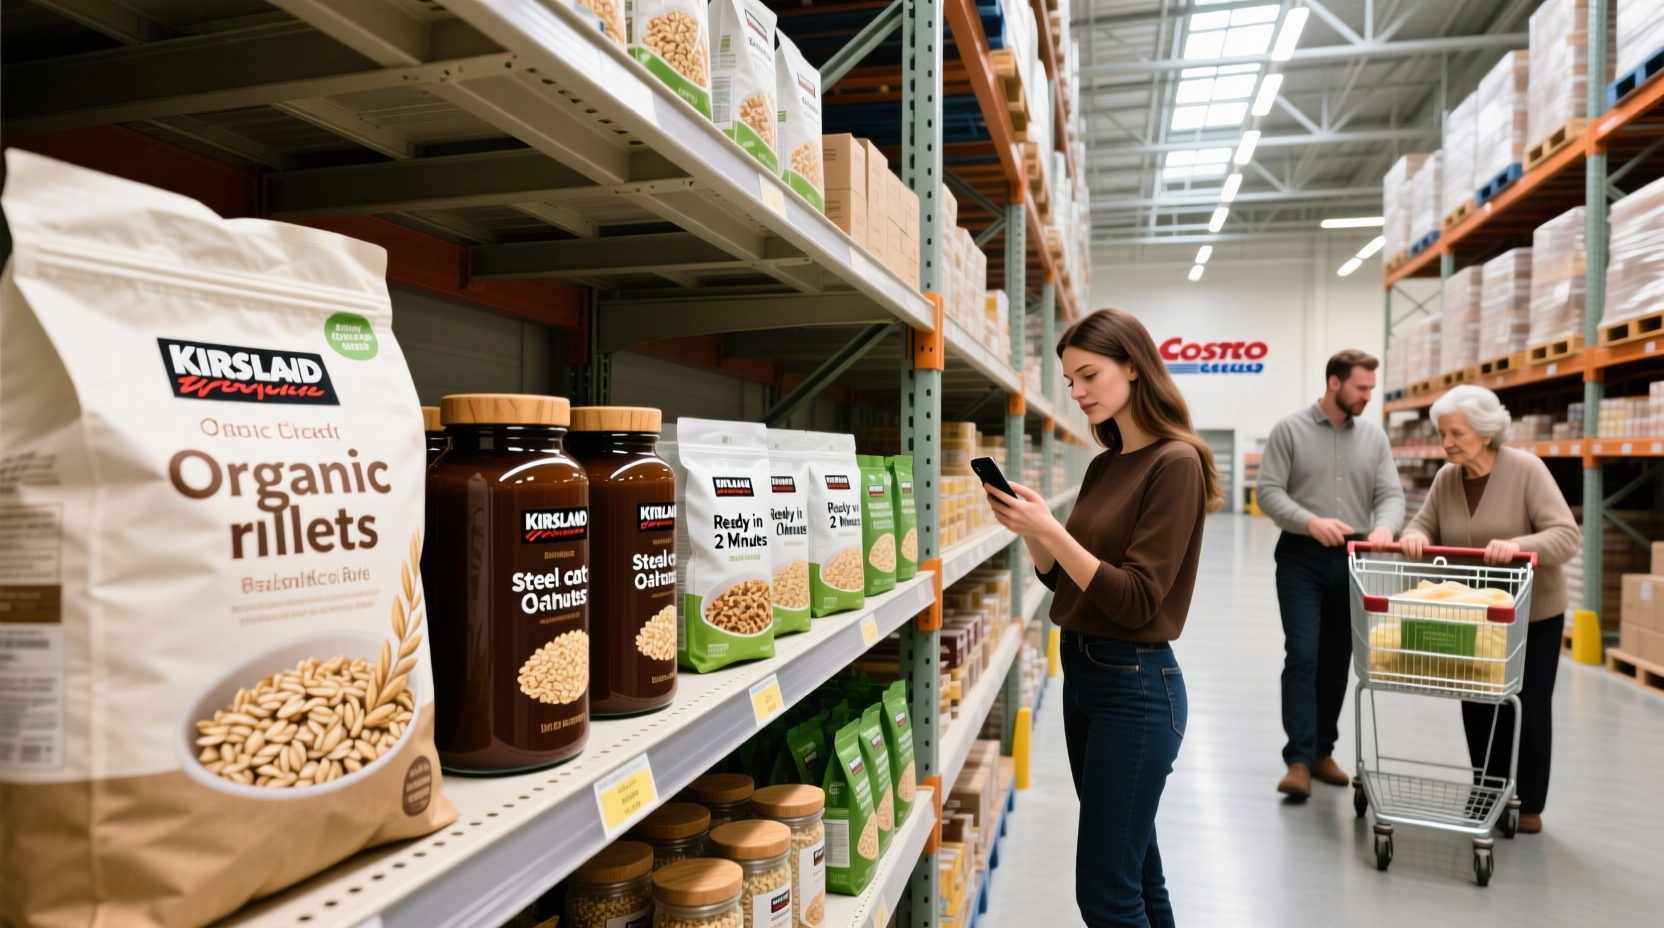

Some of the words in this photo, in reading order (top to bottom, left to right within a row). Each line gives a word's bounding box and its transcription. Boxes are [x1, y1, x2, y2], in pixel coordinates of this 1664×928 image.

[169, 448, 392, 512] Organic
[752, 513, 764, 529] in
[829, 515, 837, 529] 2
[714, 534, 725, 550] 2
[512, 567, 560, 592] Steel
